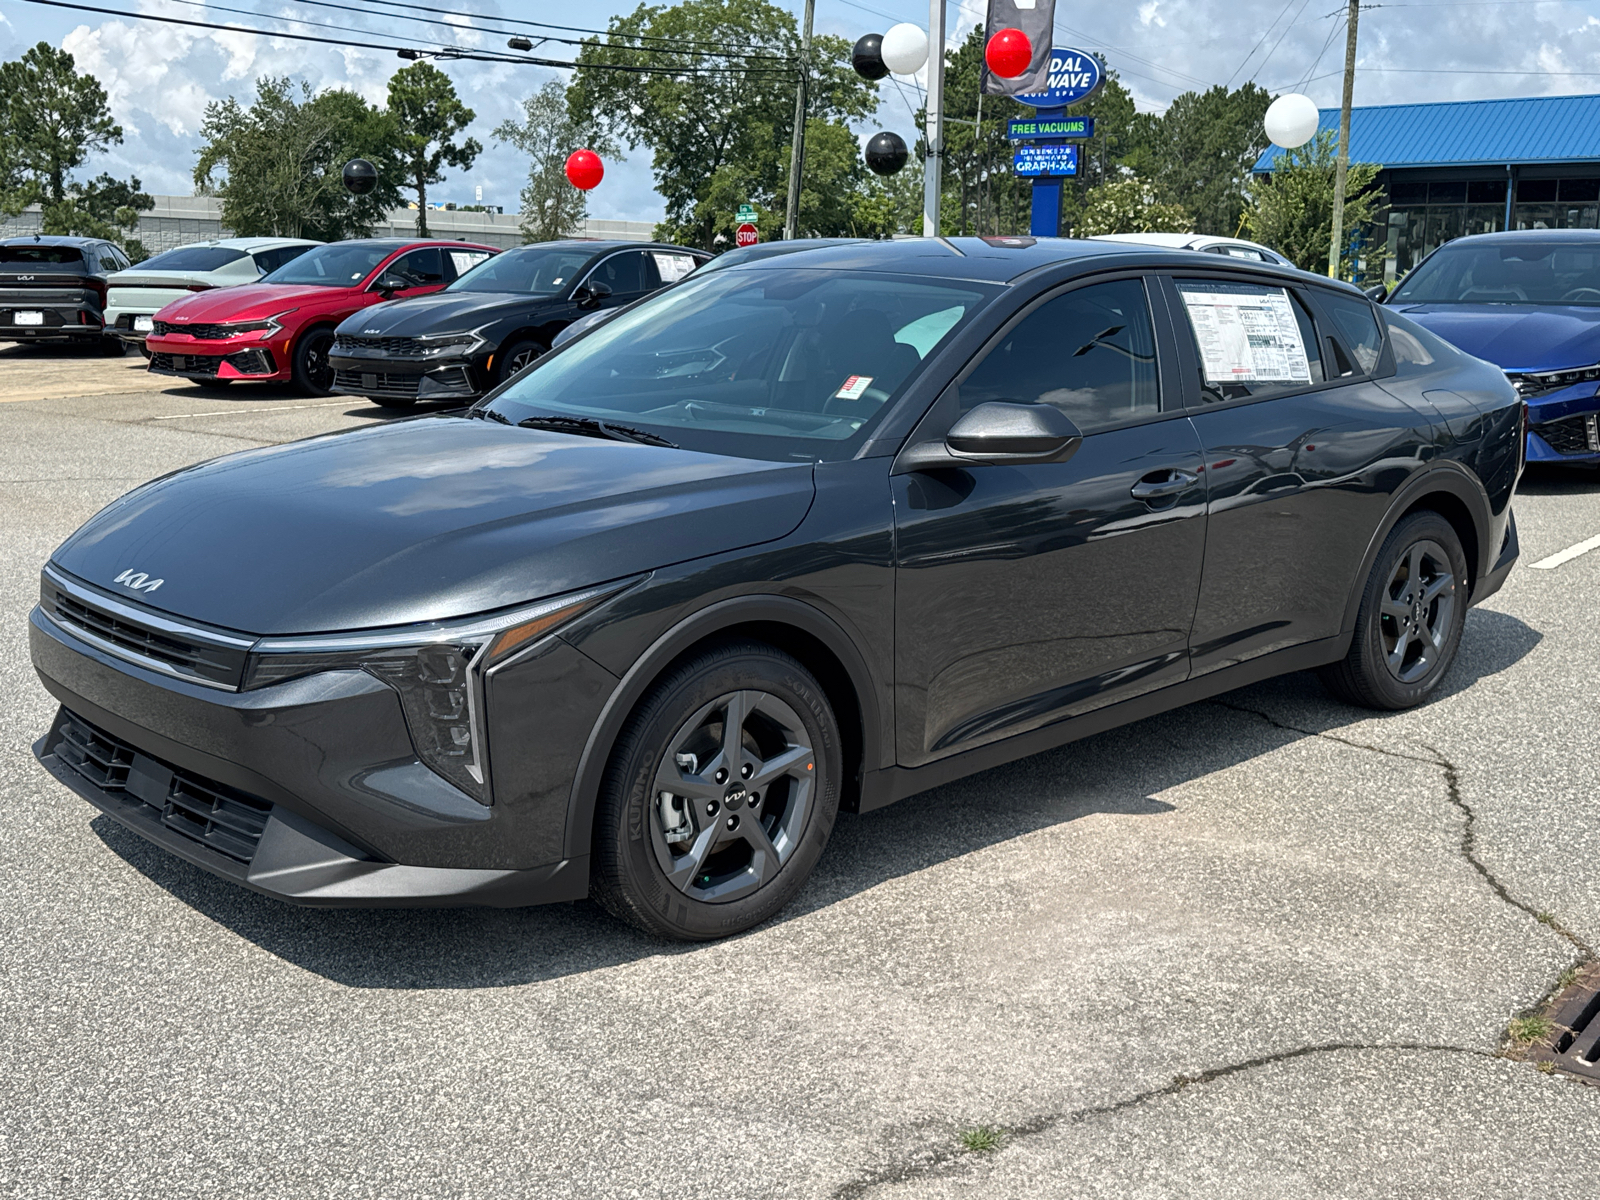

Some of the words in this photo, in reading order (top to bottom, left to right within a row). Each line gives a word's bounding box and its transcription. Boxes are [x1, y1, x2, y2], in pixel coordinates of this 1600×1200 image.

[1011, 123, 1036, 135] FREE
[1038, 121, 1085, 133] VACUUMS
[1016, 160, 1076, 172] GRAPH-X4
[738, 231, 757, 243] STOP
[113, 568, 165, 593] KIA
[629, 750, 656, 841] KUMHO
